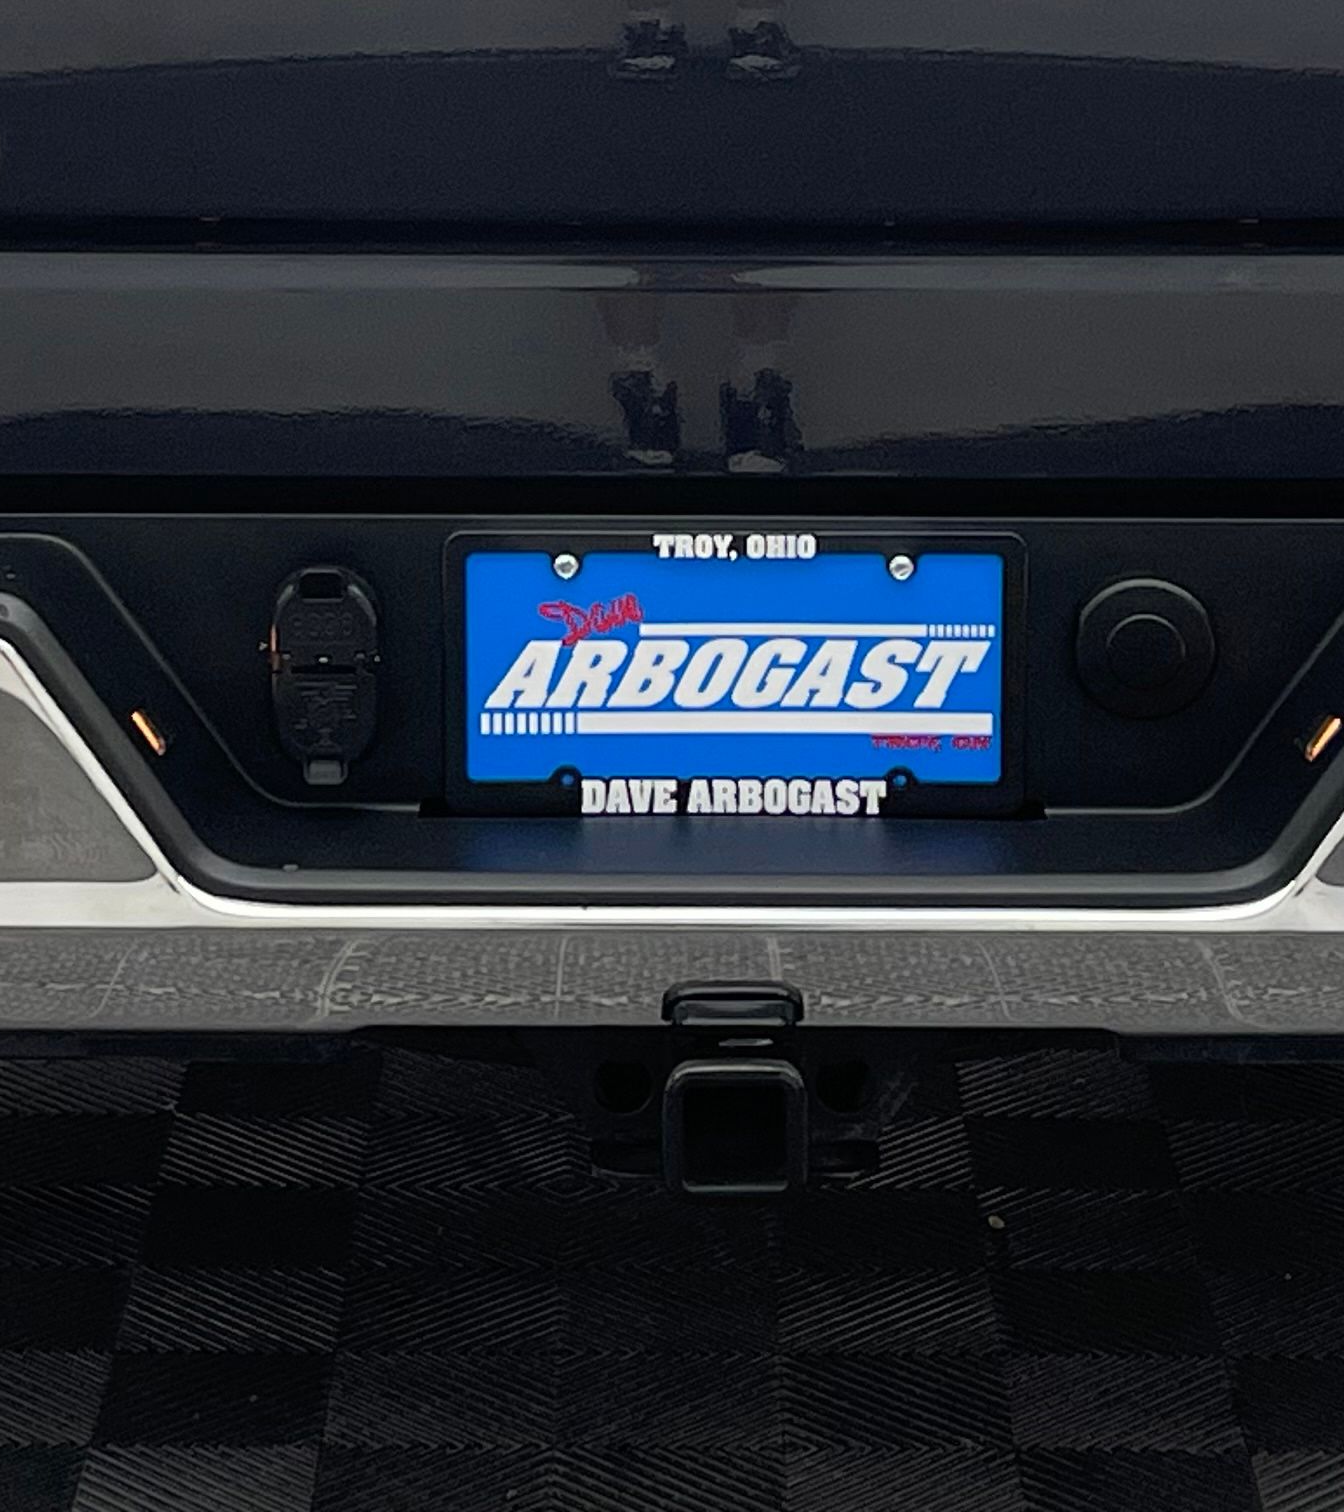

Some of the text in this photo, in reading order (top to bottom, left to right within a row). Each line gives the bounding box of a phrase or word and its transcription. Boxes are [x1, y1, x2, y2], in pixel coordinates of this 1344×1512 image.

[653, 533, 817, 562] TROY, OHIO
[484, 637, 991, 709] ARBOGAST
[581, 778, 887, 815] DAVE ARBOGAST
